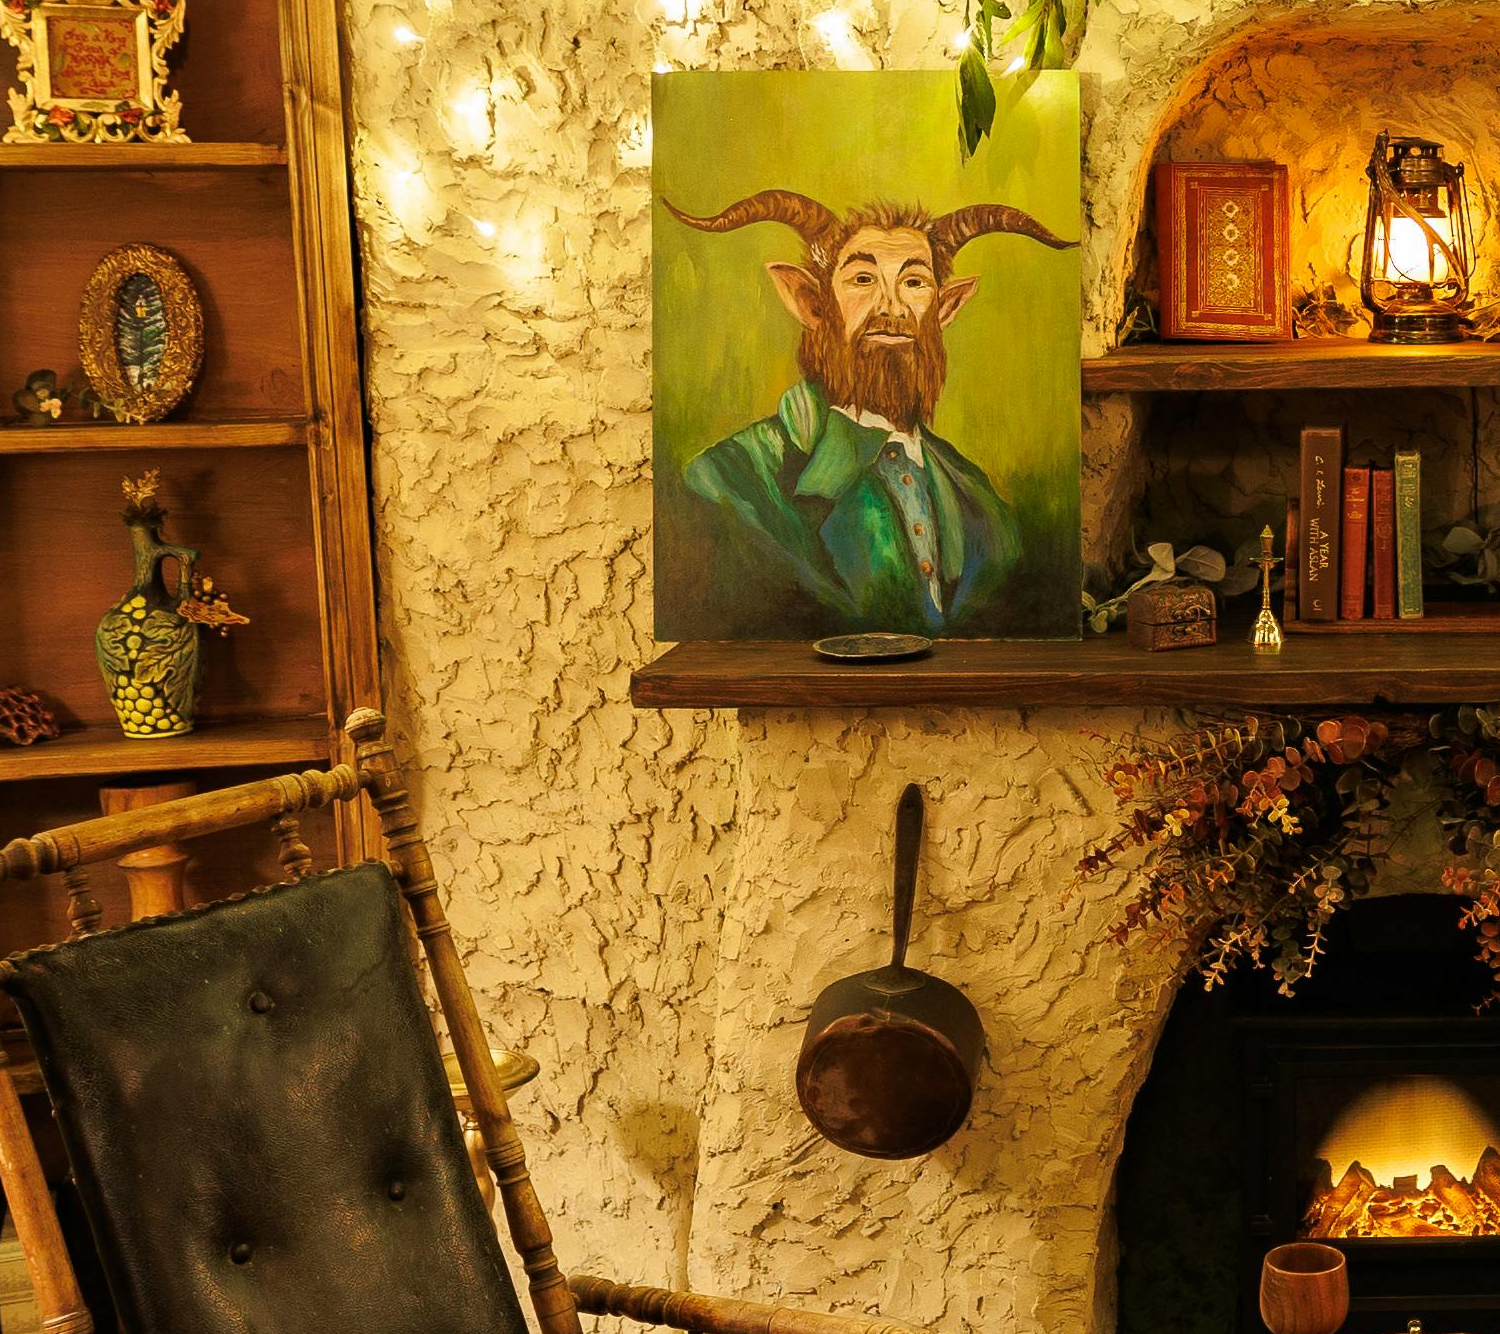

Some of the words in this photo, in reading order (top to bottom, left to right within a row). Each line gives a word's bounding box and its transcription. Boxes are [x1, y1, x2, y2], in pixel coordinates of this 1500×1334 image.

[1309, 517, 1320, 544] WITH
[1320, 531, 1329, 540] A
[1309, 547, 1320, 582] ASLAN
[1319, 542, 1330, 569] YEAR
